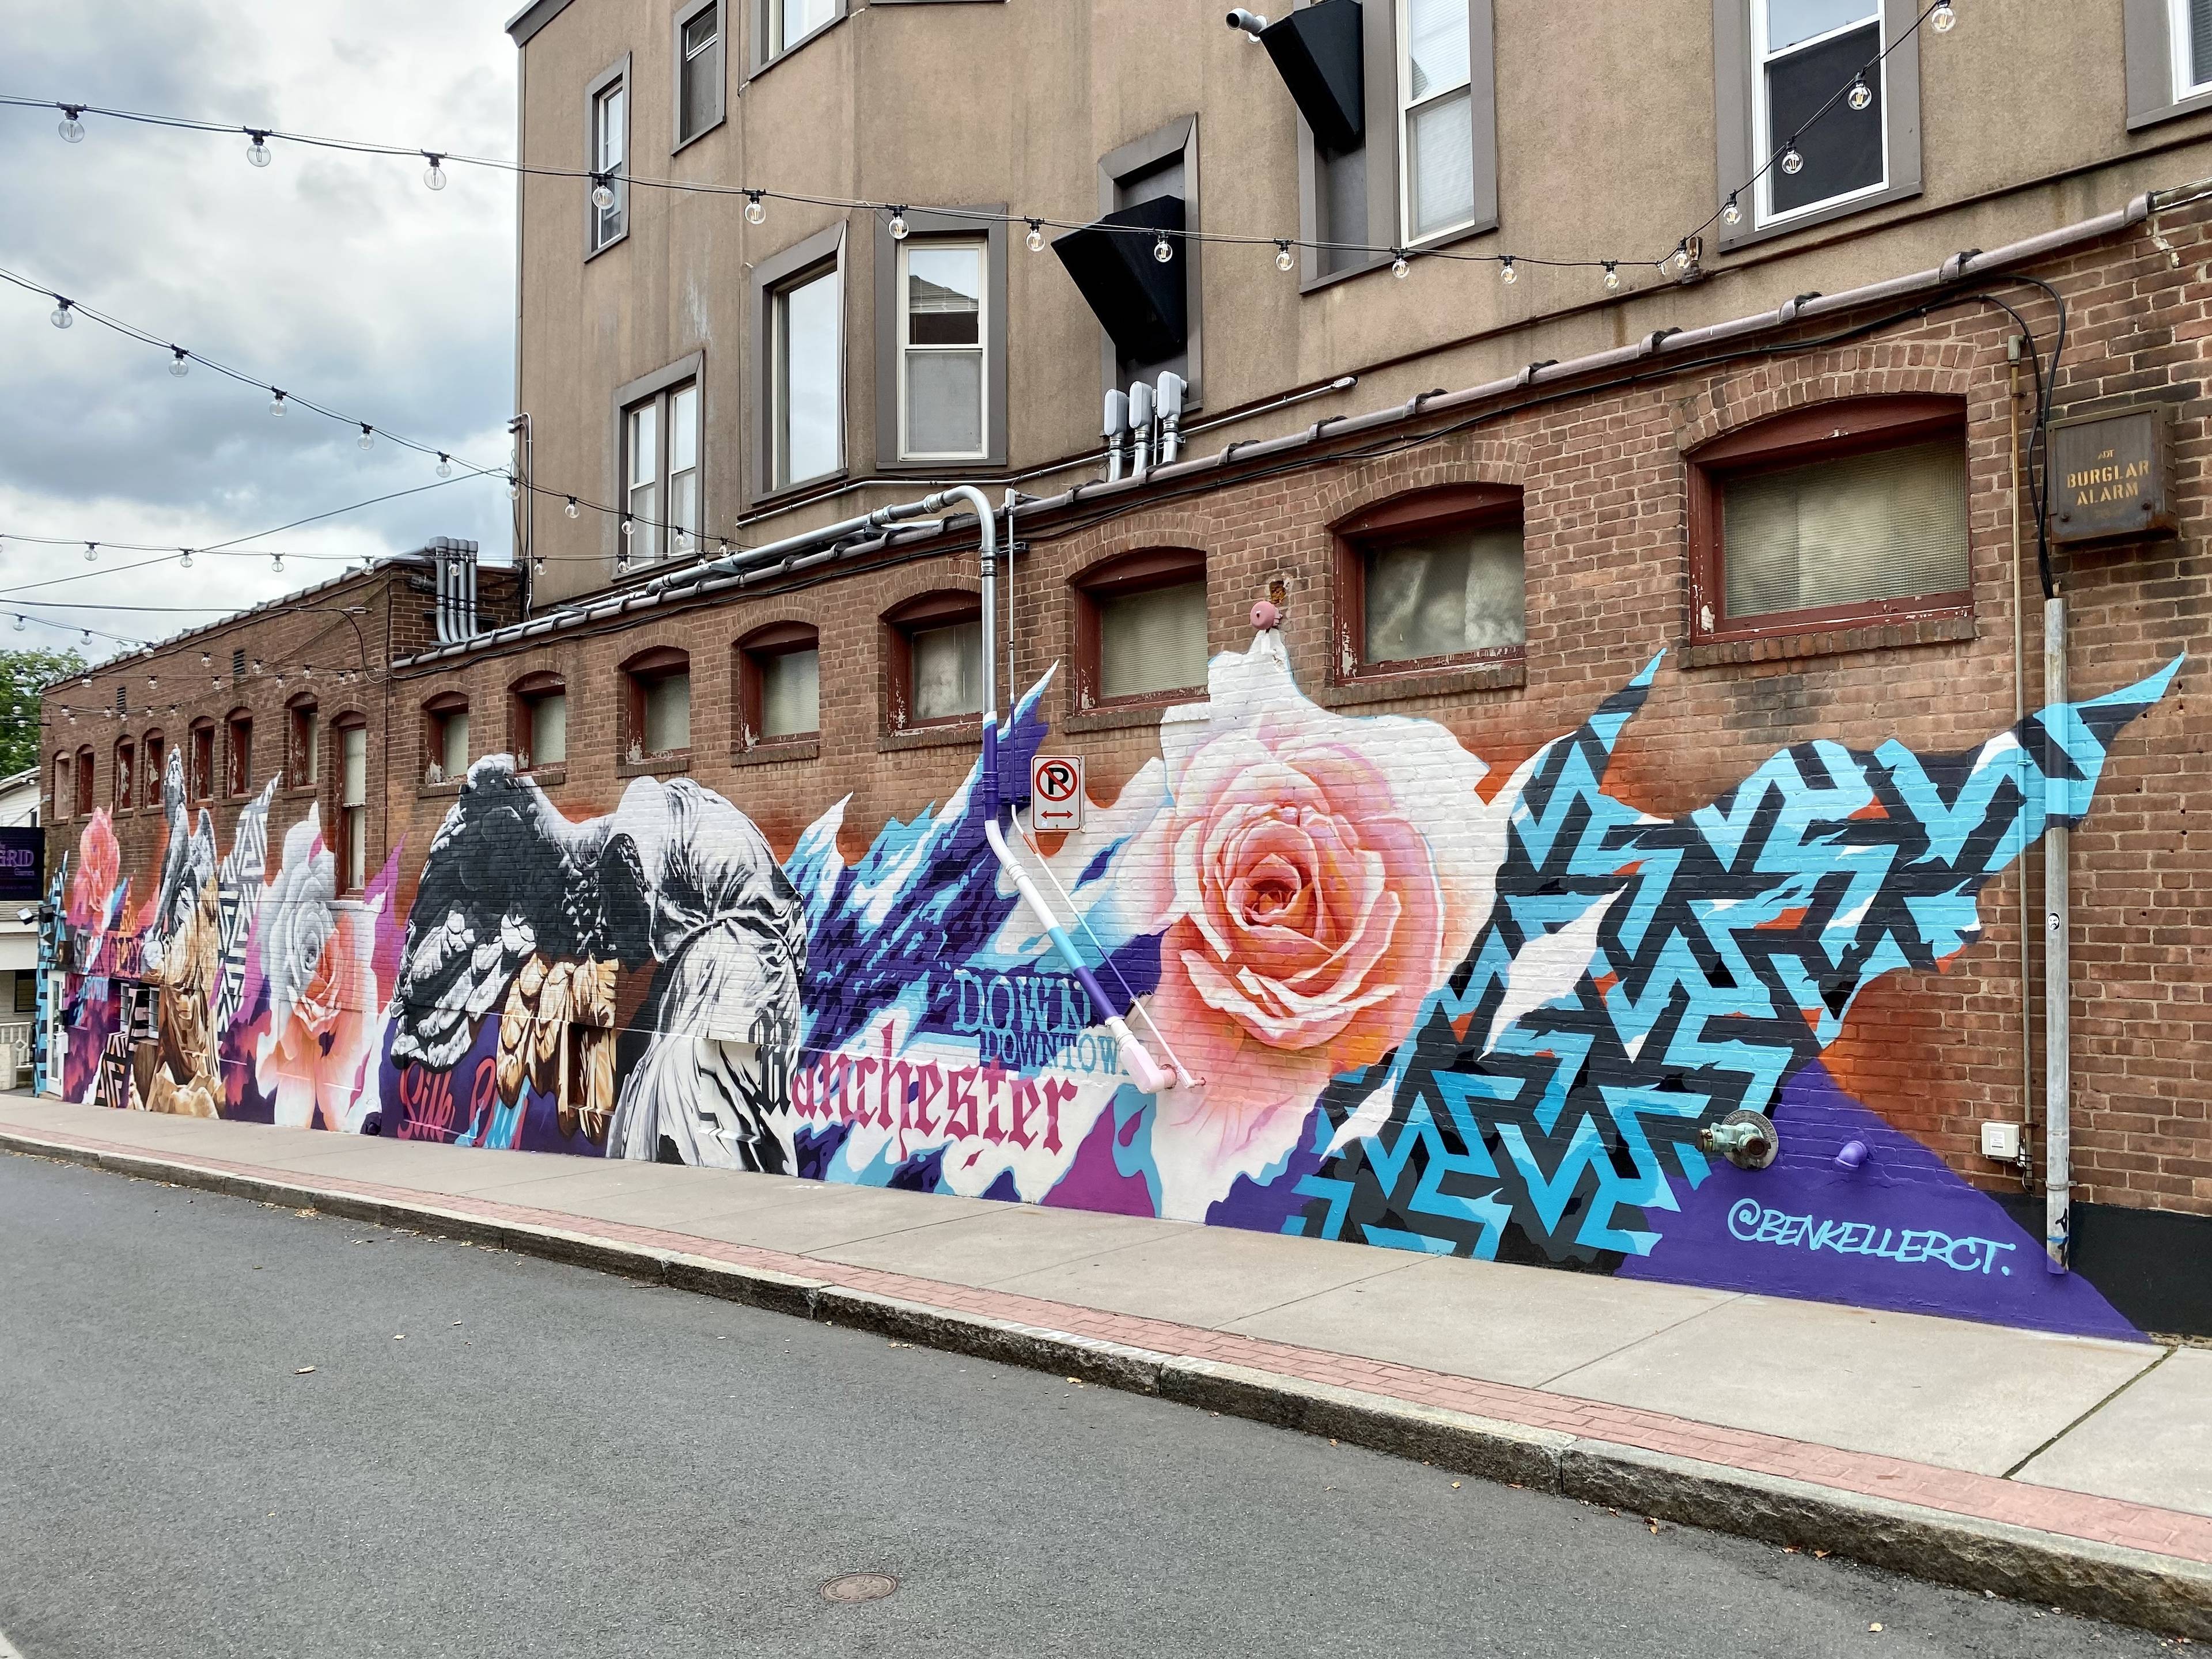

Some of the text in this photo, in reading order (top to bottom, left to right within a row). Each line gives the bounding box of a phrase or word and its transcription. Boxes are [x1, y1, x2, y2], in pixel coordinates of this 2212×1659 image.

[2066, 460, 2150, 488] BURGLAR
[2075, 482, 2139, 506] ALARM
[952, 968, 1092, 1034] DOWN
[980, 1029, 1130, 1076] DOWNTOW
[748, 1008, 1079, 1158] Manchester
